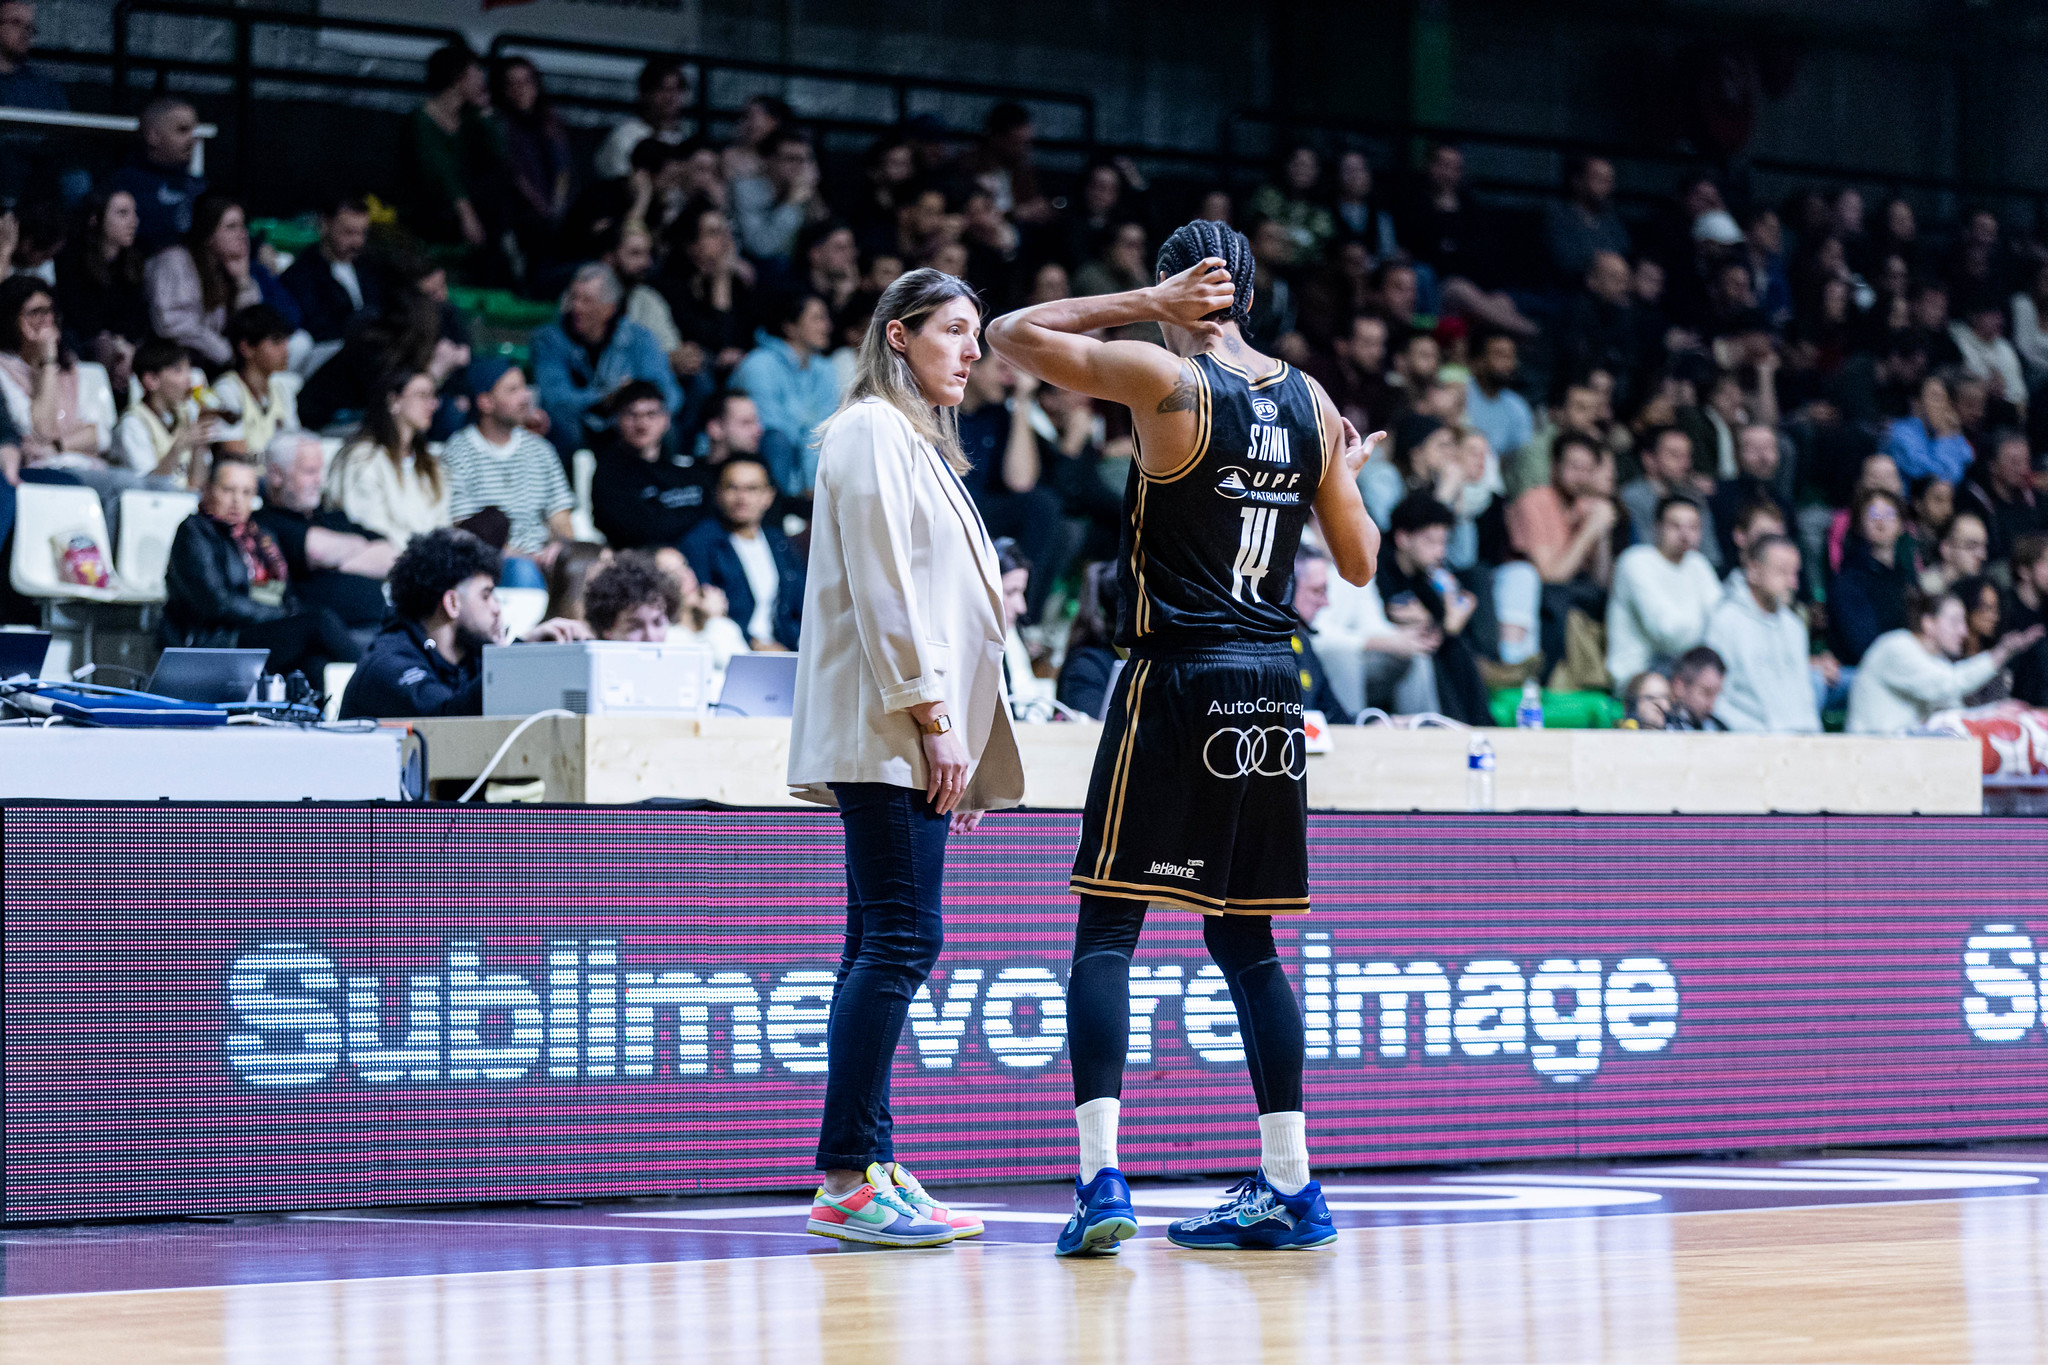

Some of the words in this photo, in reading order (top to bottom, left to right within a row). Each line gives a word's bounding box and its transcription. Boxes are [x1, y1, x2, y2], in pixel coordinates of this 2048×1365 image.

[1254, 404, 1275, 415] STB
[1250, 490, 1300, 502] PATRIMOINE
[1252, 471, 1301, 489] UPF
[1231, 506, 1279, 603] 14
[225, 938, 838, 1086] Sublime
[906, 964, 1247, 1068] vore
[1302, 931, 1680, 1085] image
[1962, 924, 2048, 1043] S
